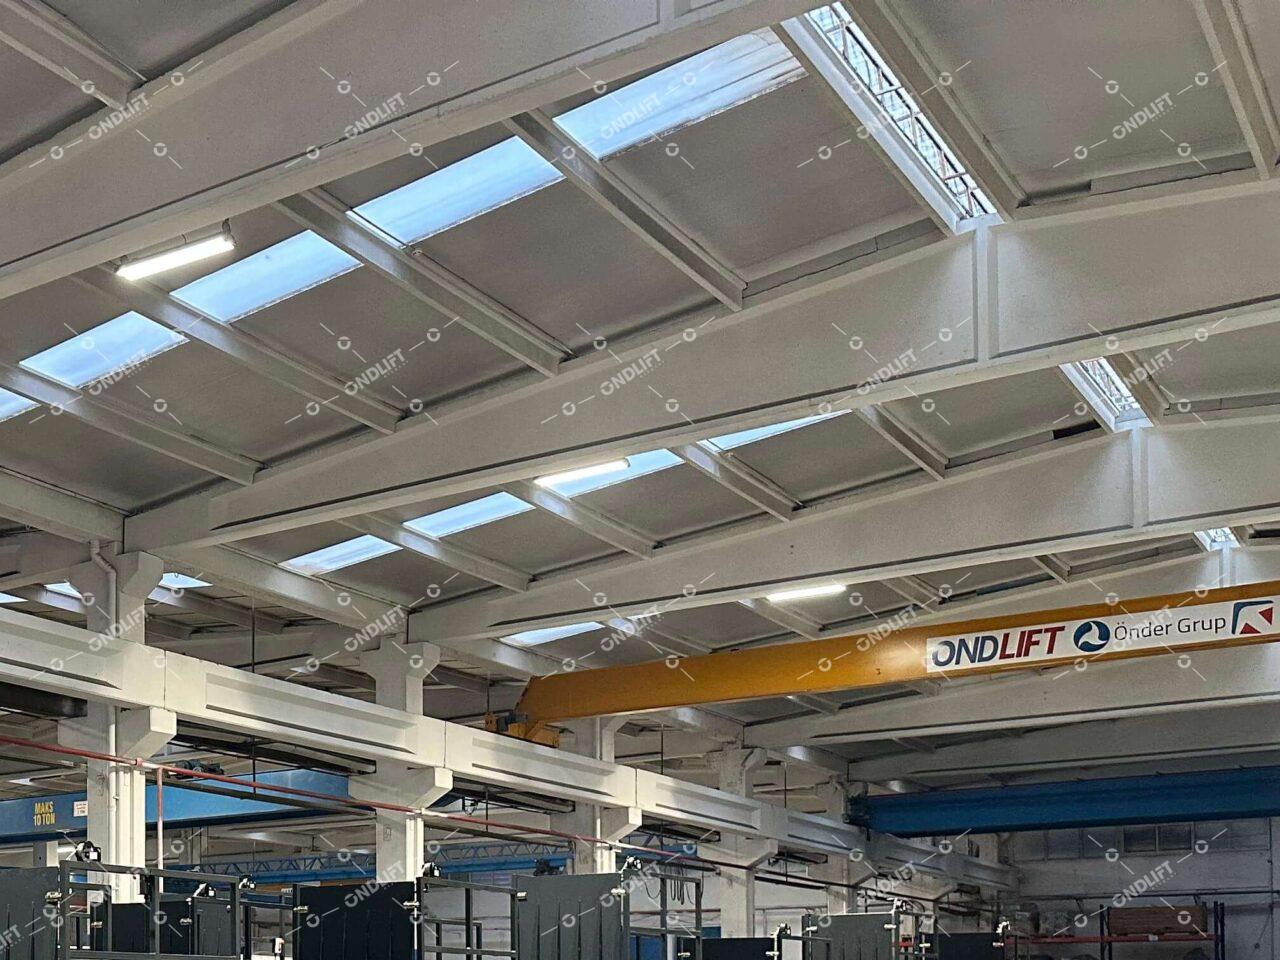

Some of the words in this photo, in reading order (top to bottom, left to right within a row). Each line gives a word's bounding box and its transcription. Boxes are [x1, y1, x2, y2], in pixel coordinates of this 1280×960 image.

[1114, 621, 1173, 641] Önder
[1177, 617, 1227, 634] Grup
[932, 626, 1066, 667] ONDLIFT
[34, 801, 54, 814] MAKS
[33, 814, 42, 826] 10
[42, 812, 56, 825] TON
